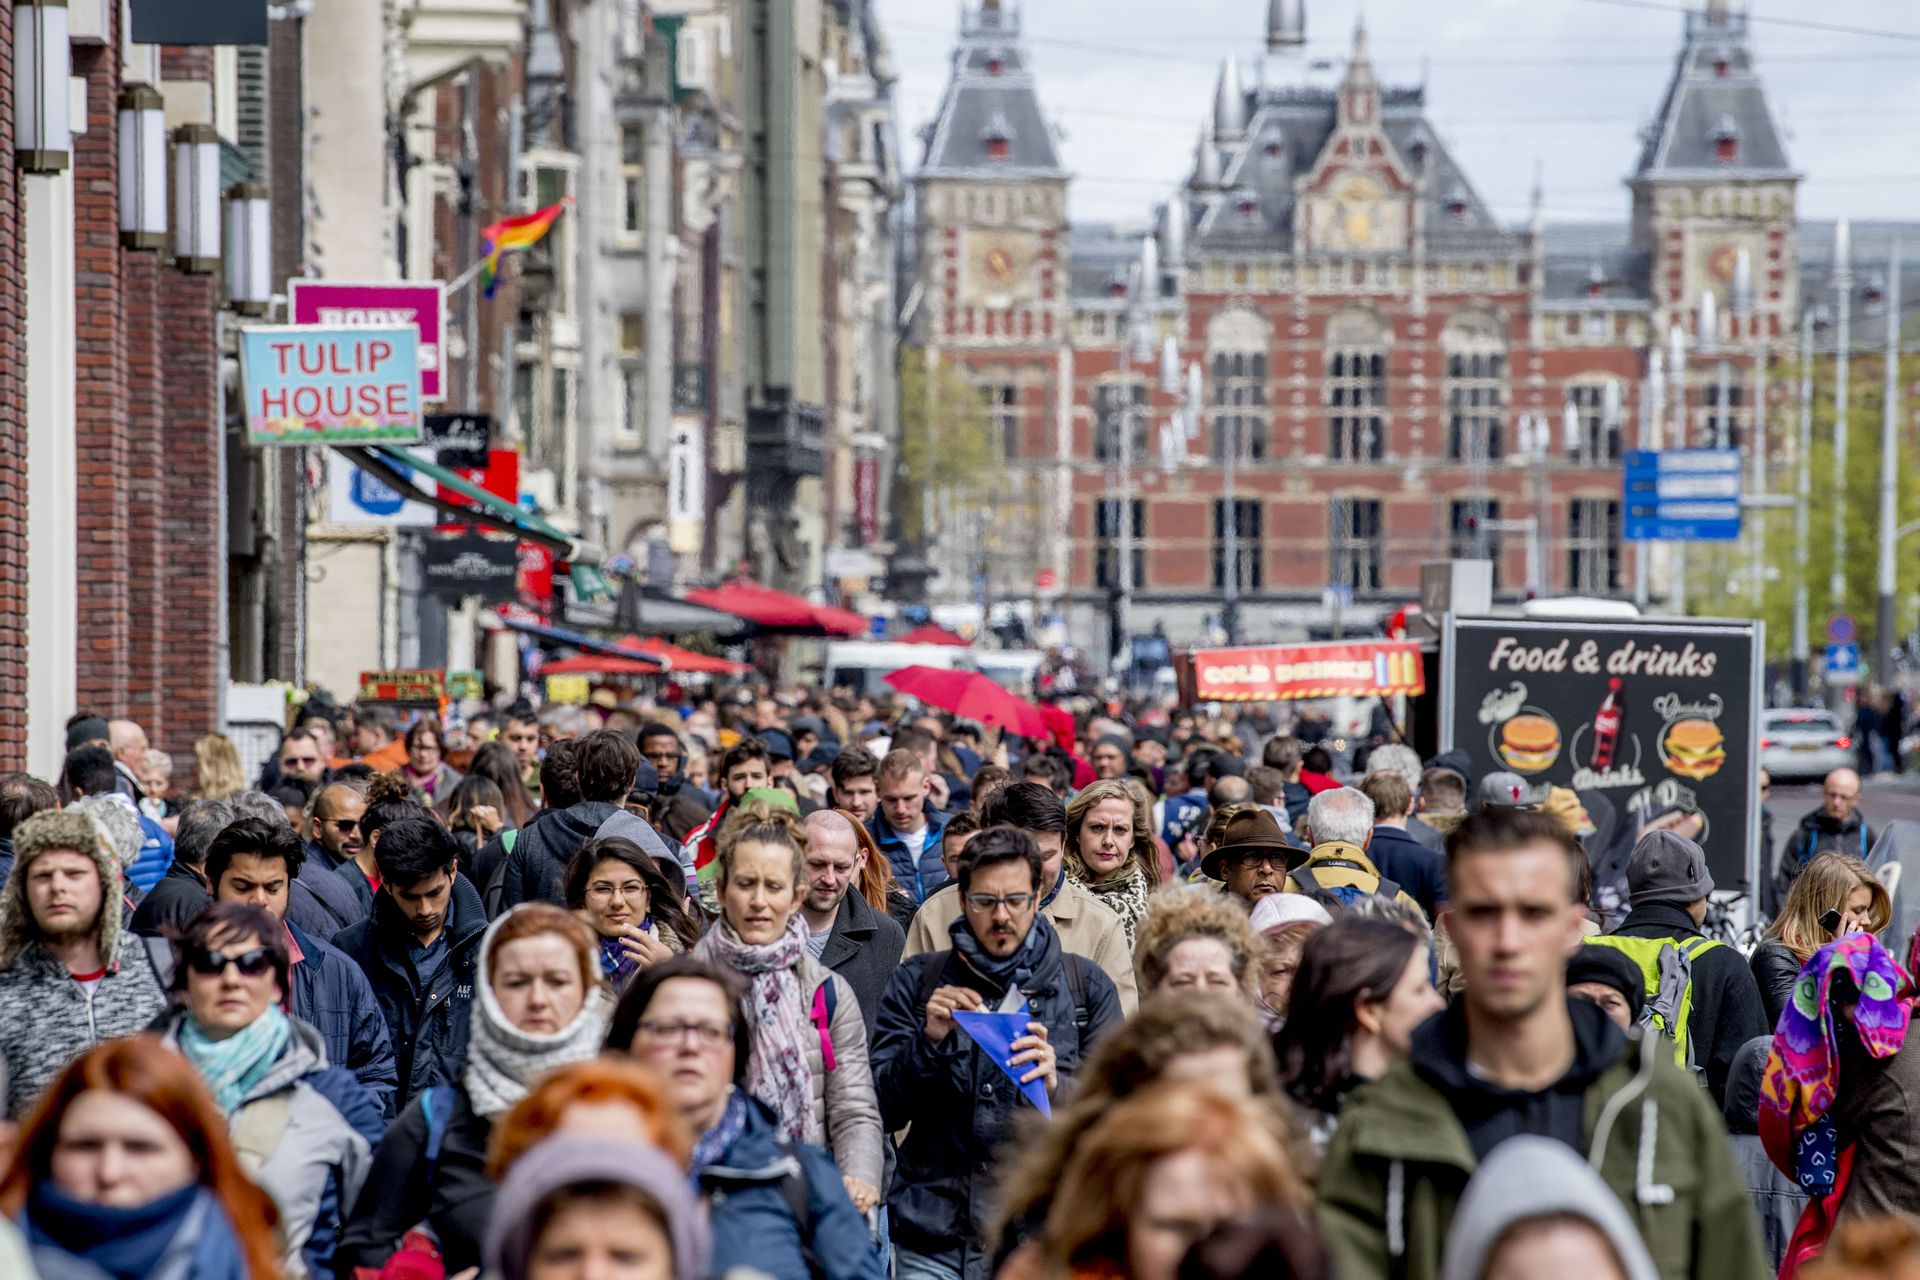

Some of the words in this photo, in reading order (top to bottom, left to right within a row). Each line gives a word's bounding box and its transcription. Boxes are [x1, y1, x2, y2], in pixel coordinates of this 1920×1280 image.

[270, 341, 393, 375] TULIP
[261, 384, 409, 419] HOUSE
[1203, 664, 1271, 684] COLD
[1274, 660, 1374, 683] DRINKS
[1489, 637, 1570, 673] Food
[1572, 639, 1600, 674] &
[1606, 640, 1717, 678] drinks
[457, 985, 472, 994] A&F
